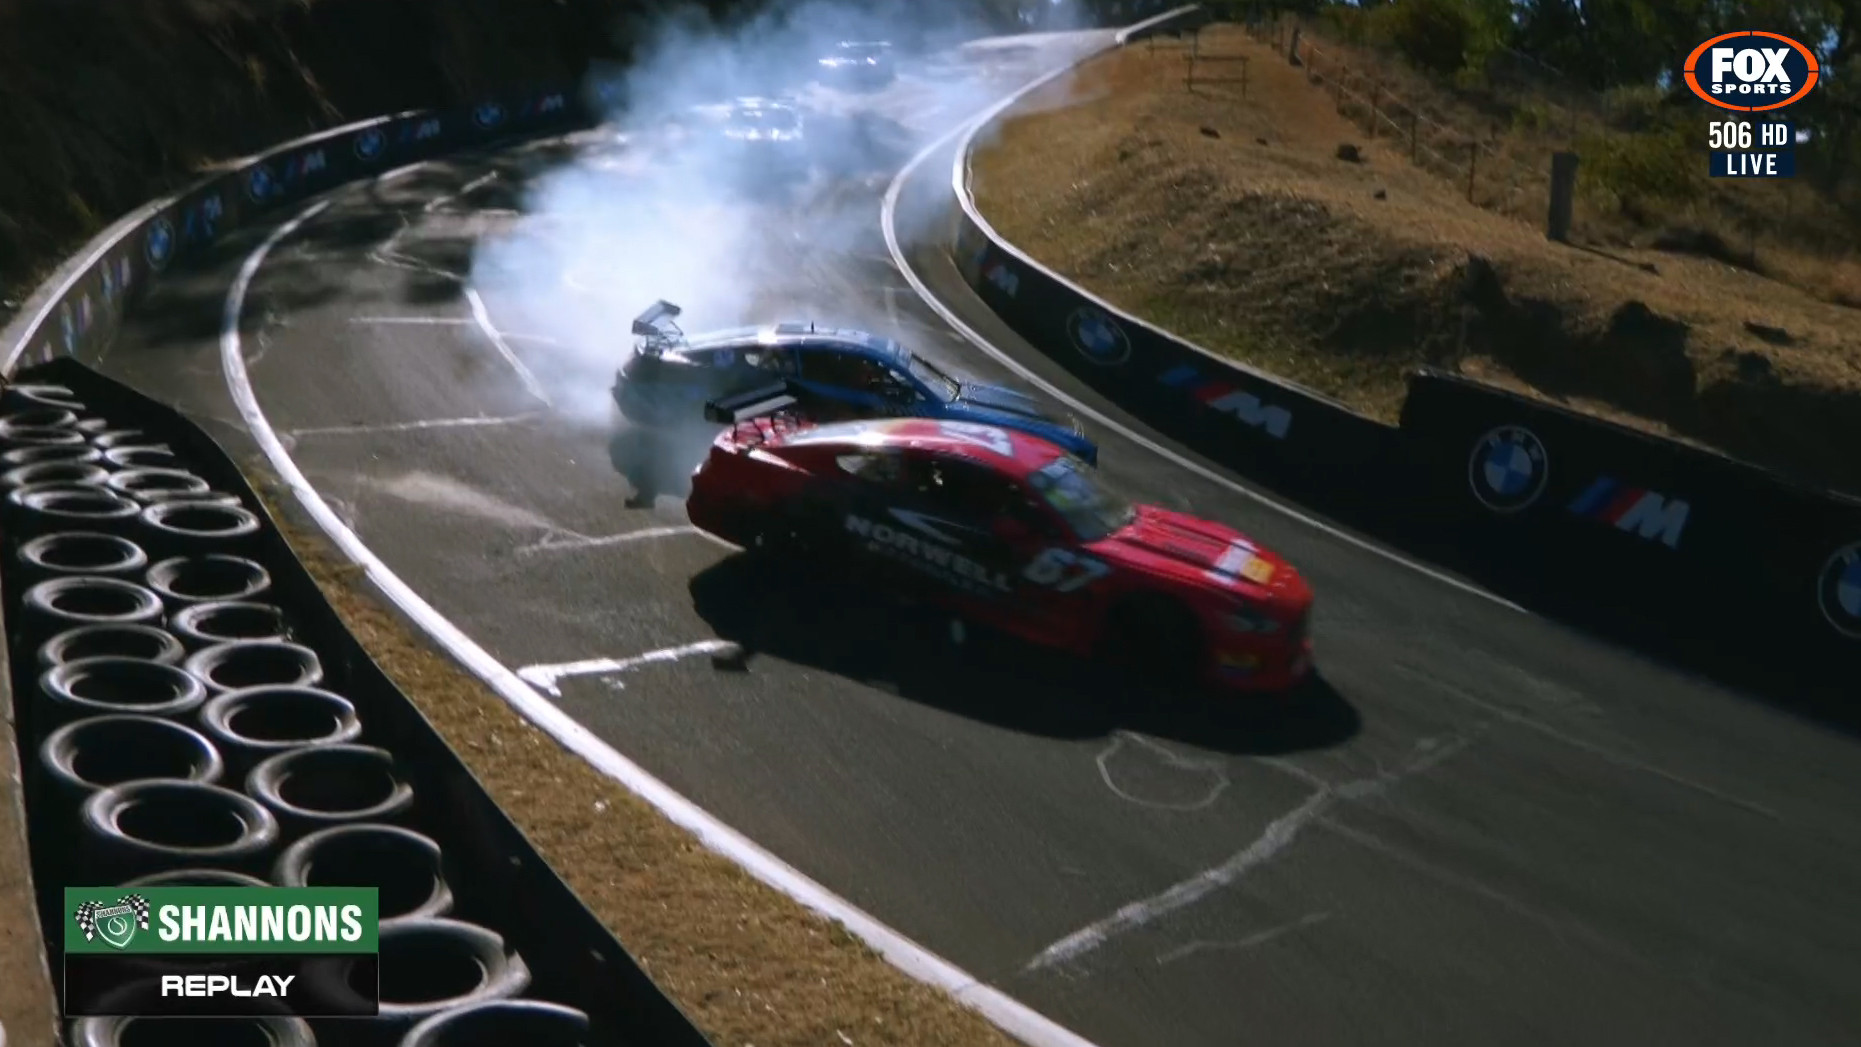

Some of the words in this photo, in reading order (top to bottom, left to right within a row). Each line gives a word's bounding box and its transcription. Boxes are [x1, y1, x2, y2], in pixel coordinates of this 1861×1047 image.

[1208, 391, 1292, 439] M
[1614, 490, 1691, 550] M
[844, 513, 1015, 592] NORWELL
[1022, 546, 1114, 593] 67
